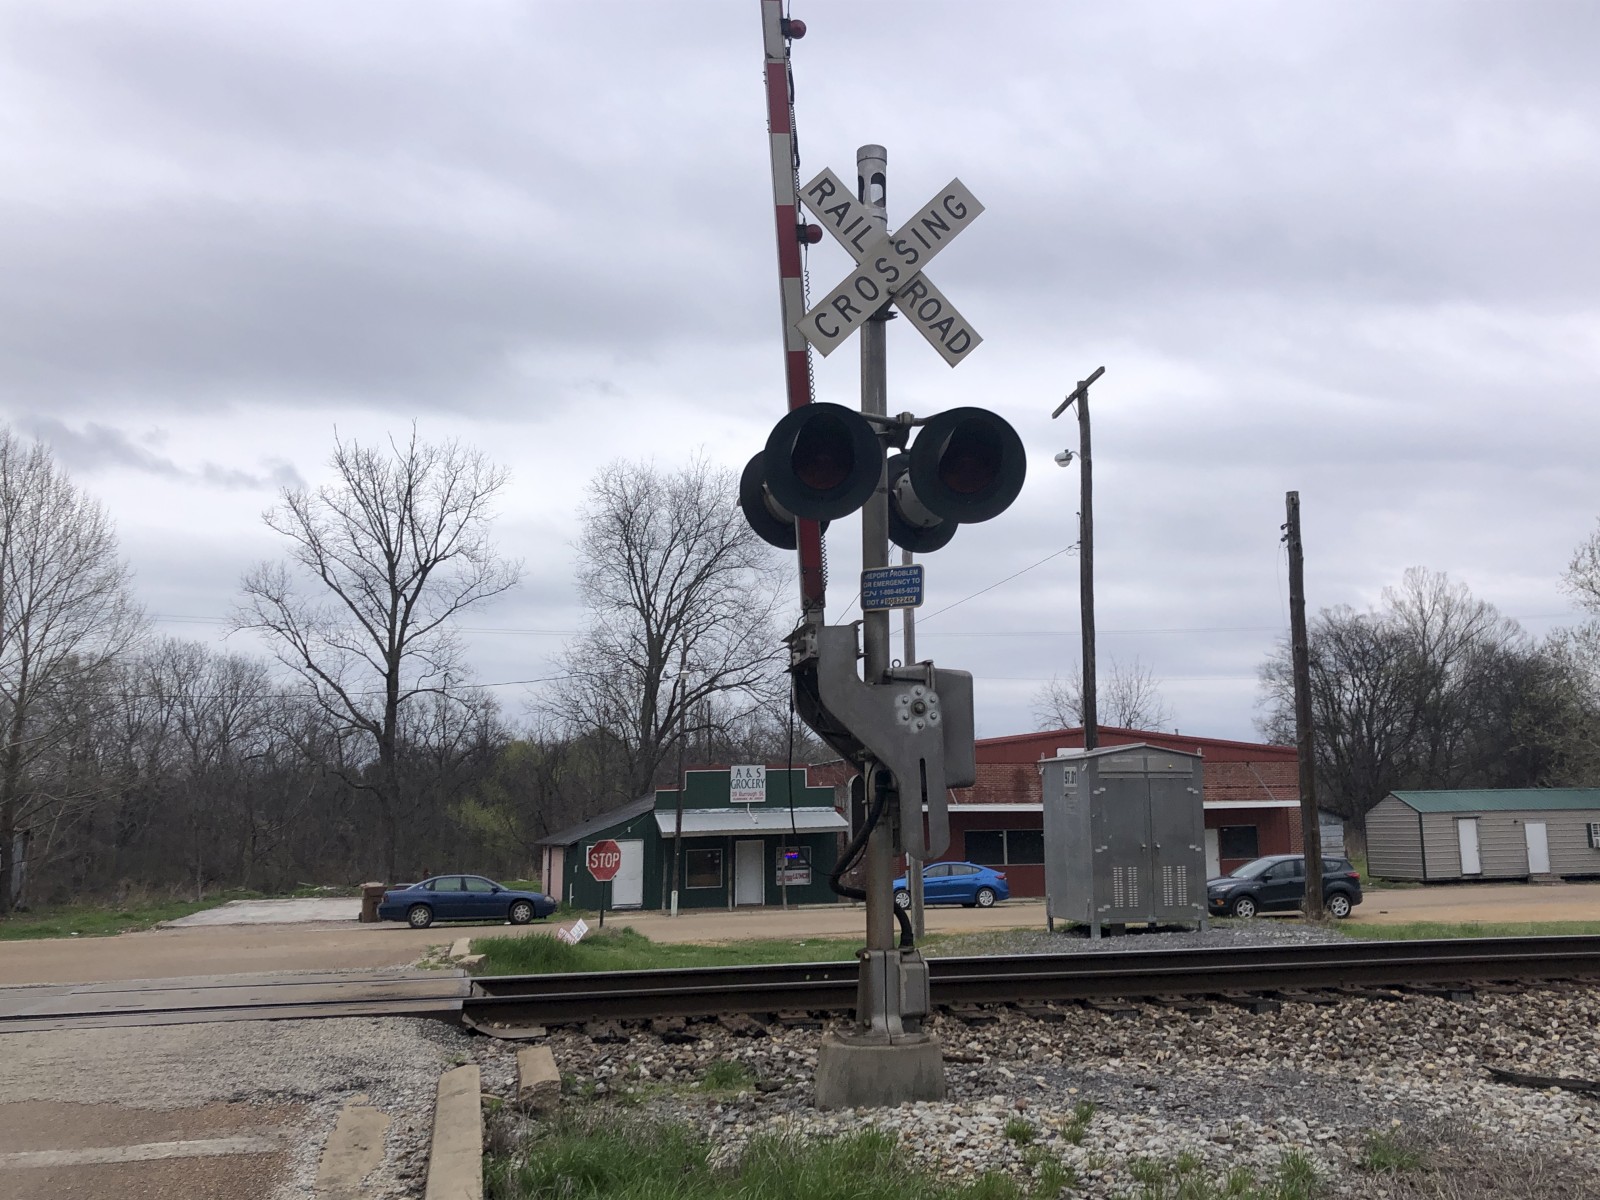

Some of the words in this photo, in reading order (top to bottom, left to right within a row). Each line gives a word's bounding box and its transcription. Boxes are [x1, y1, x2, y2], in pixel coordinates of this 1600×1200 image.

[808, 177, 872, 254] RAIL
[901, 279, 971, 355] ROAD
[814, 194, 967, 338] CROSSING
[889, 569, 918, 577] PROBLEM
[863, 581, 872, 589] OR
[873, 579, 911, 588] EMERGENCY
[736, 768, 742, 778] A
[746, 768, 752, 778] &
[756, 768, 761, 778] S
[731, 778, 766, 789] GROCERY
[590, 852, 620, 869] STOP
